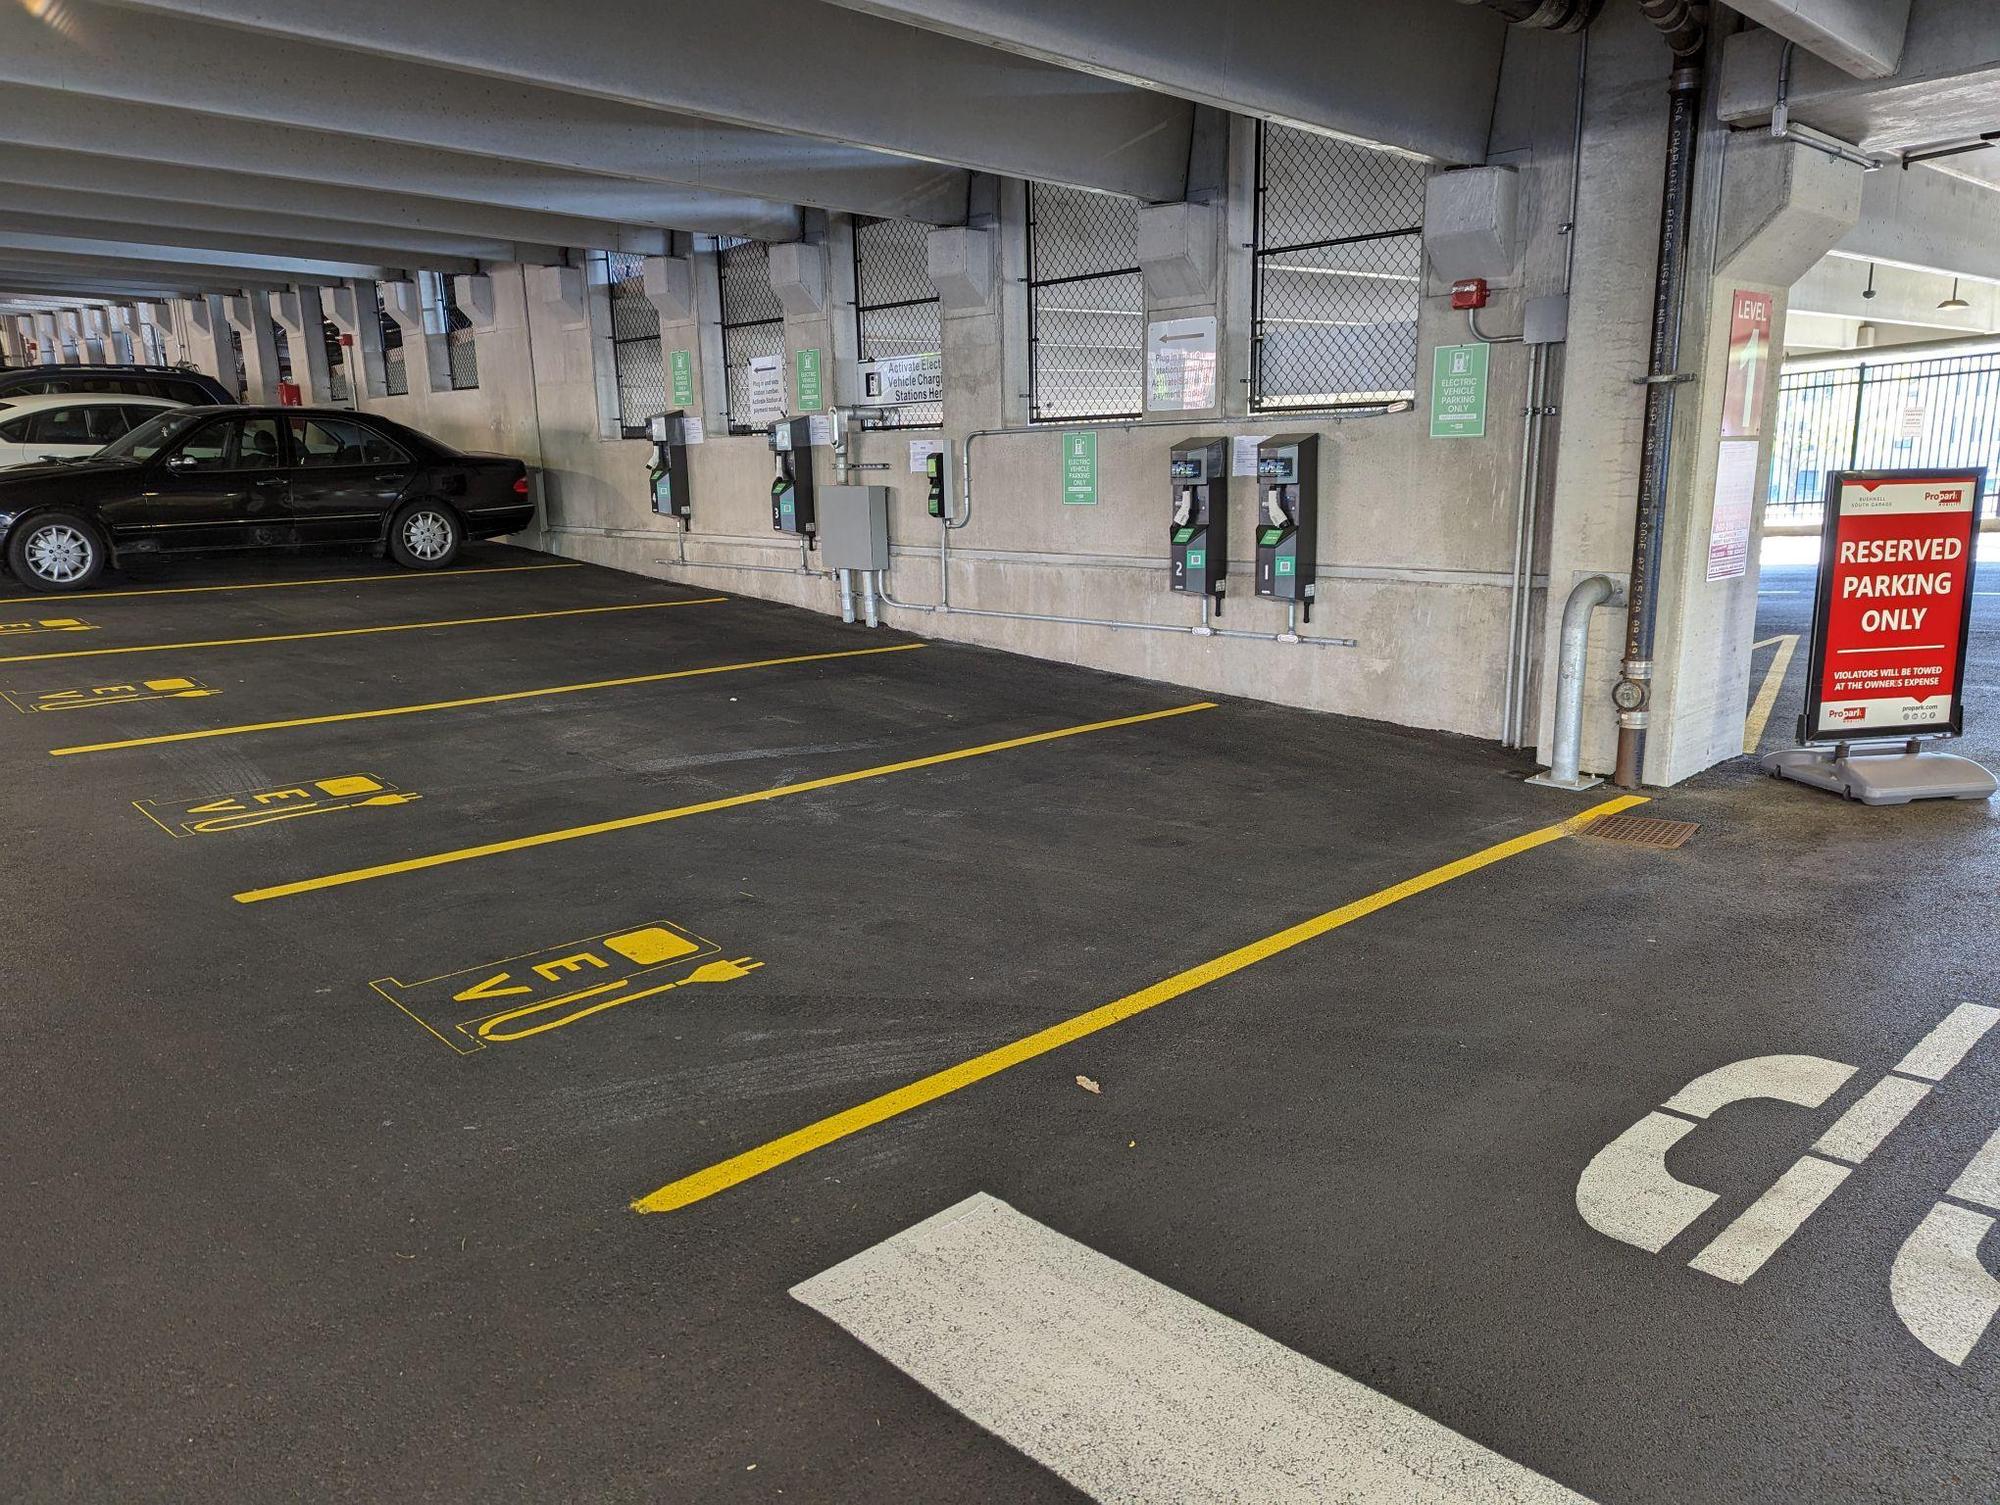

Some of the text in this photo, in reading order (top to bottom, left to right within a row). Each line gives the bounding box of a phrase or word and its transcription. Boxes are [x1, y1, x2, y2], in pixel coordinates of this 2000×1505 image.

[1666, 129, 1681, 201] CHARLOTTE
[1738, 299, 1767, 321] LEVEL
[888, 361, 920, 374] Activate
[888, 376, 919, 387] Vehicle
[1441, 378, 1477, 387] ELECTRIC
[1739, 328, 1760, 428] 1
[895, 389, 928, 401] Stations
[1443, 386, 1476, 396] VEHICLE
[1441, 395, 1476, 405] PARKING
[1448, 404, 1469, 413] ONLY
[1840, 537, 1962, 564] RESERVED
[1175, 561, 1183, 576] 2
[1264, 564, 1269, 580] 1
[1843, 572, 1951, 599] PARKING
[1861, 607, 1928, 633] ONLY
[1834, 666, 1943, 680] VIOLATORS WILL BE TOWED
[1834, 682, 1845, 691] AT
[1845, 681, 1863, 690] THE
[1904, 677, 1939, 687] EXPENSE
[1902, 703, 1938, 713] propark.com
